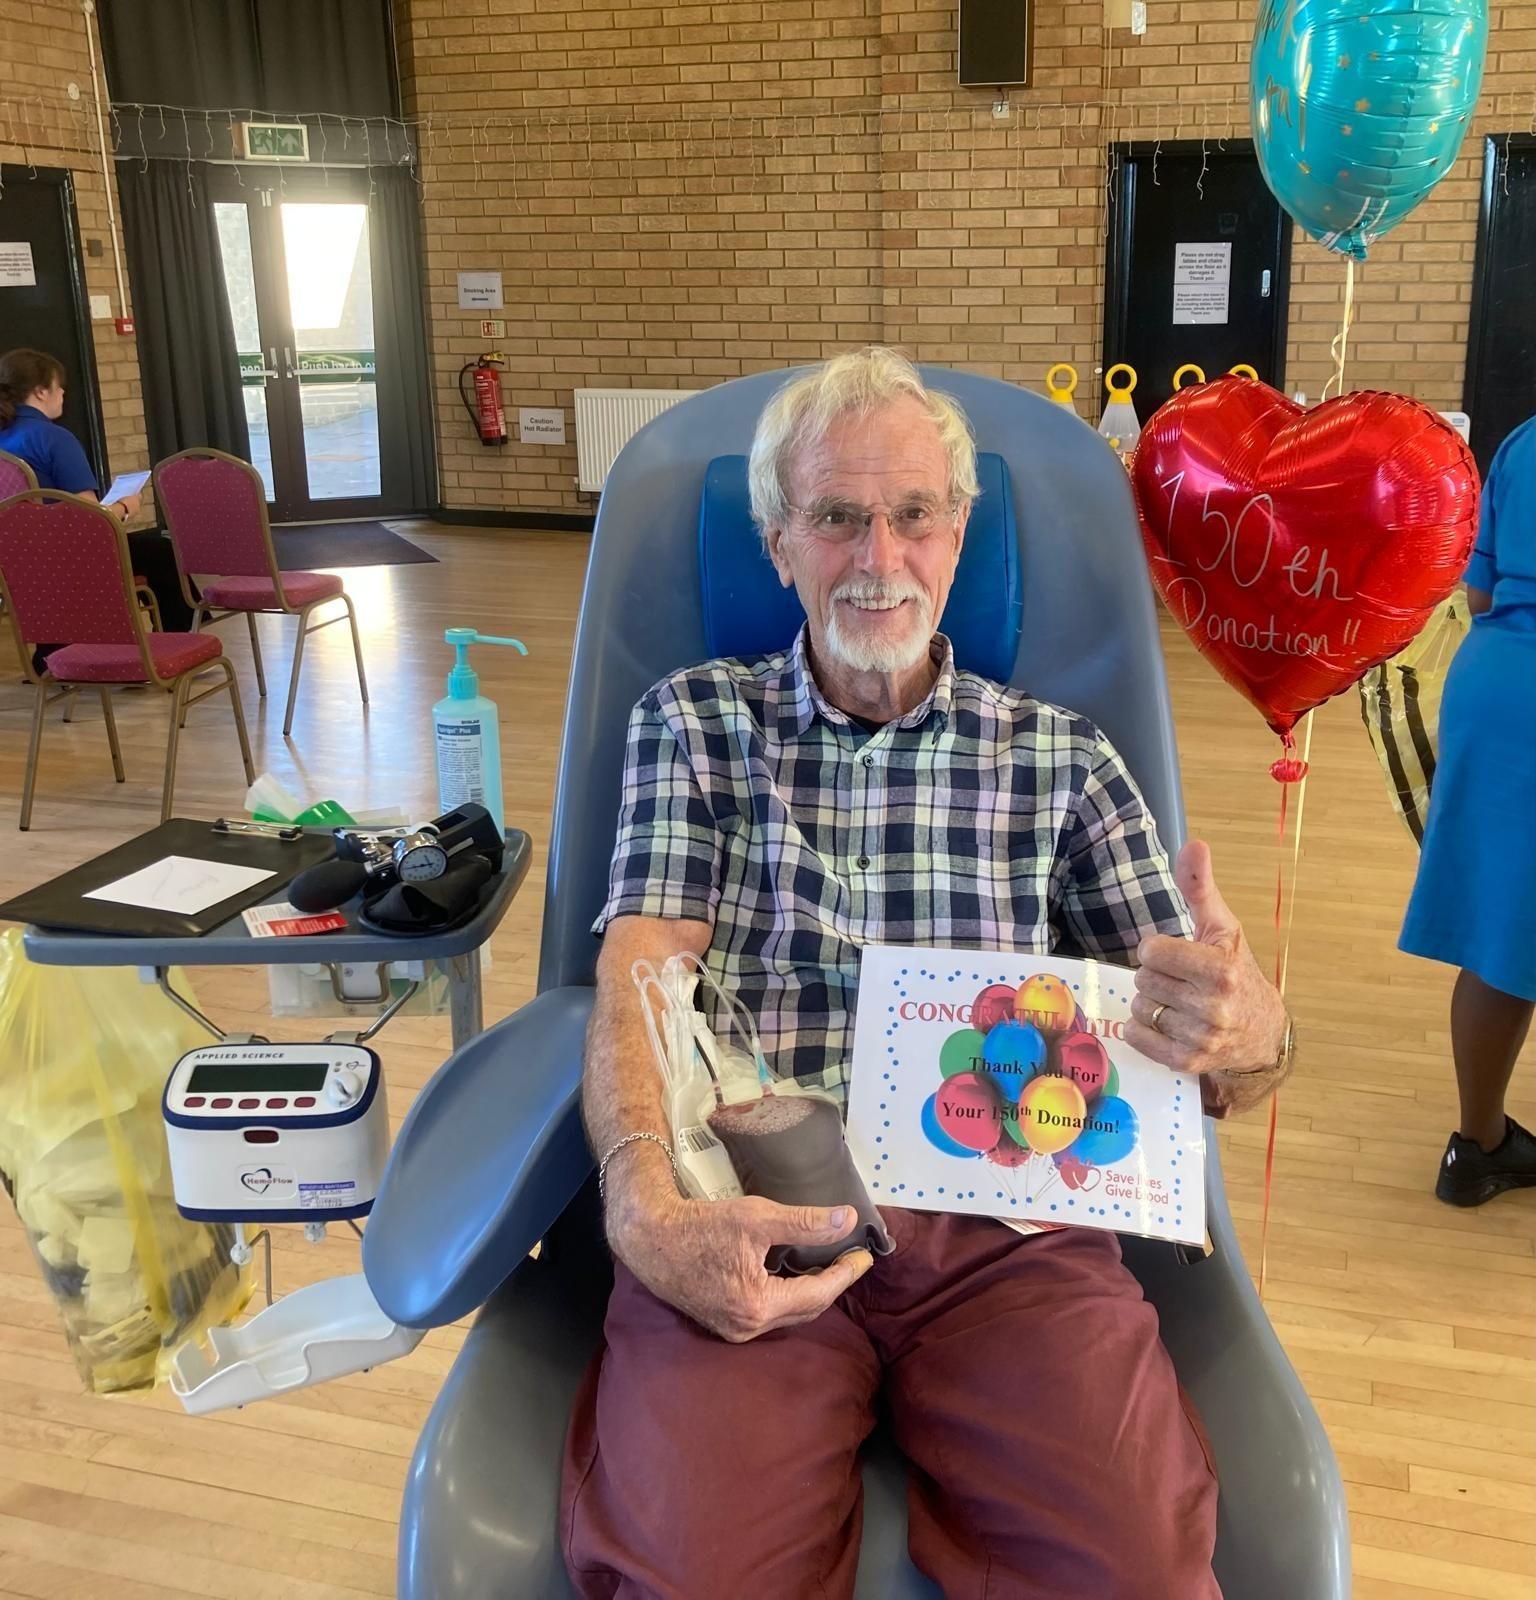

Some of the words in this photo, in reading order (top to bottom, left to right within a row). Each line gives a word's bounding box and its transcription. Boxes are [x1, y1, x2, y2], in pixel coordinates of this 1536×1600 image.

[529, 417, 554, 425] Caution
[536, 425, 562, 433] Radiator
[899, 1000, 1127, 1042] CONGRATULATIO
[969, 1056, 1024, 1075] Thank
[1030, 1061, 1063, 1078] You
[1070, 1065, 1100, 1083] For
[942, 1102, 986, 1120] Your
[1037, 1109, 1121, 1135] Donation!
[1105, 1169, 1135, 1185] Save
[1137, 1174, 1162, 1190] les
[1105, 1184, 1133, 1199] Give
[1135, 1187, 1169, 1205] bood
